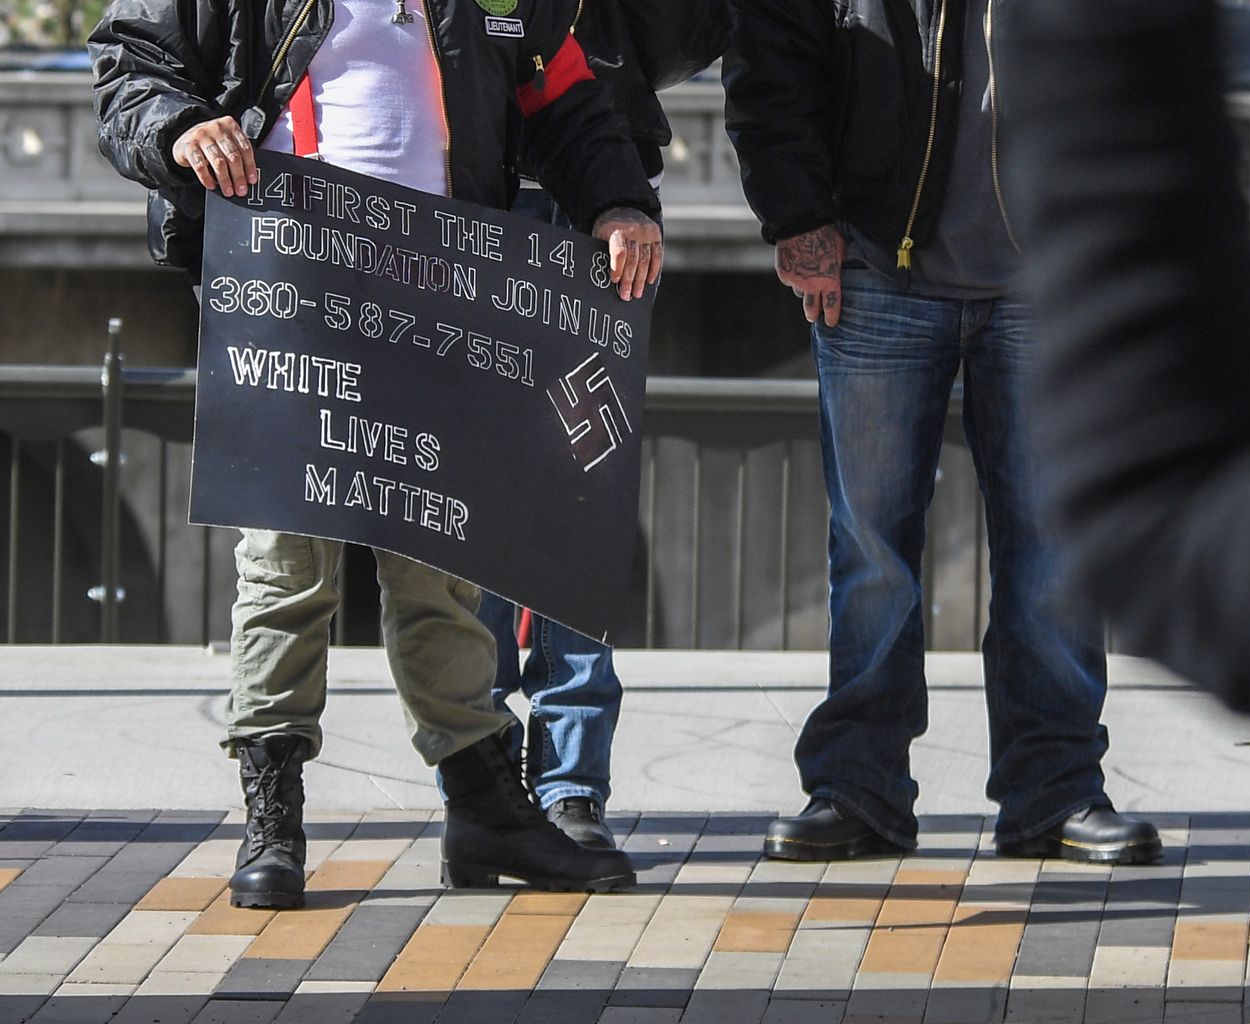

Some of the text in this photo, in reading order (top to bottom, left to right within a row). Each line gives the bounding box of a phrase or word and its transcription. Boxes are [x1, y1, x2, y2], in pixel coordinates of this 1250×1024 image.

[489, 20, 521, 33] LIEUTENANT
[247, 167, 295, 207] 14
[303, 175, 417, 236] FIRST
[434, 210, 504, 262] THE
[528, 232, 575, 278] 14
[251, 216, 477, 302] FOUNDATION
[209, 276, 536, 387] 360-587-7551
[227, 346, 362, 402] WHITE
[319, 409, 441, 472] LIVES
[304, 463, 470, 541] MATTER
